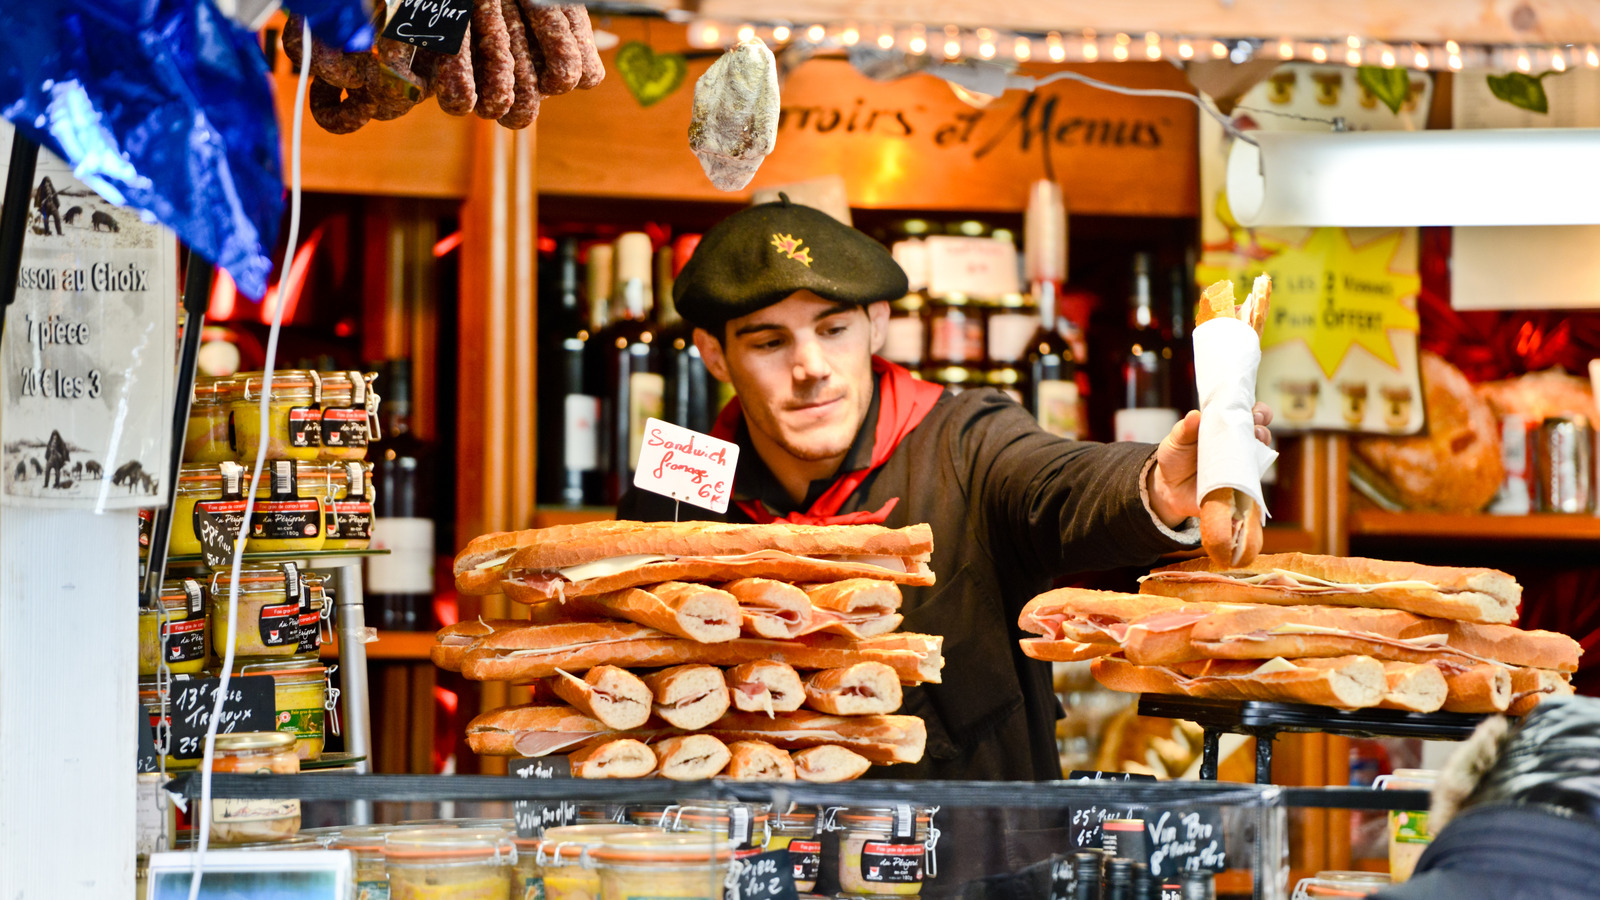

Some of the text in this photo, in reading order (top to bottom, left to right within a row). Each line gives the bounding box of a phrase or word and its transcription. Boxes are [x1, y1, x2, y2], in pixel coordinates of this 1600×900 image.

[933, 107, 987, 147] et
[974, 92, 1166, 181] Menus
[62, 268, 88, 291] au
[92, 263, 149, 291] Choix
[55, 369, 84, 398] les
[88, 369, 102, 399] 3
[648, 428, 726, 466] Sandwich
[653, 451, 709, 484] fromage
